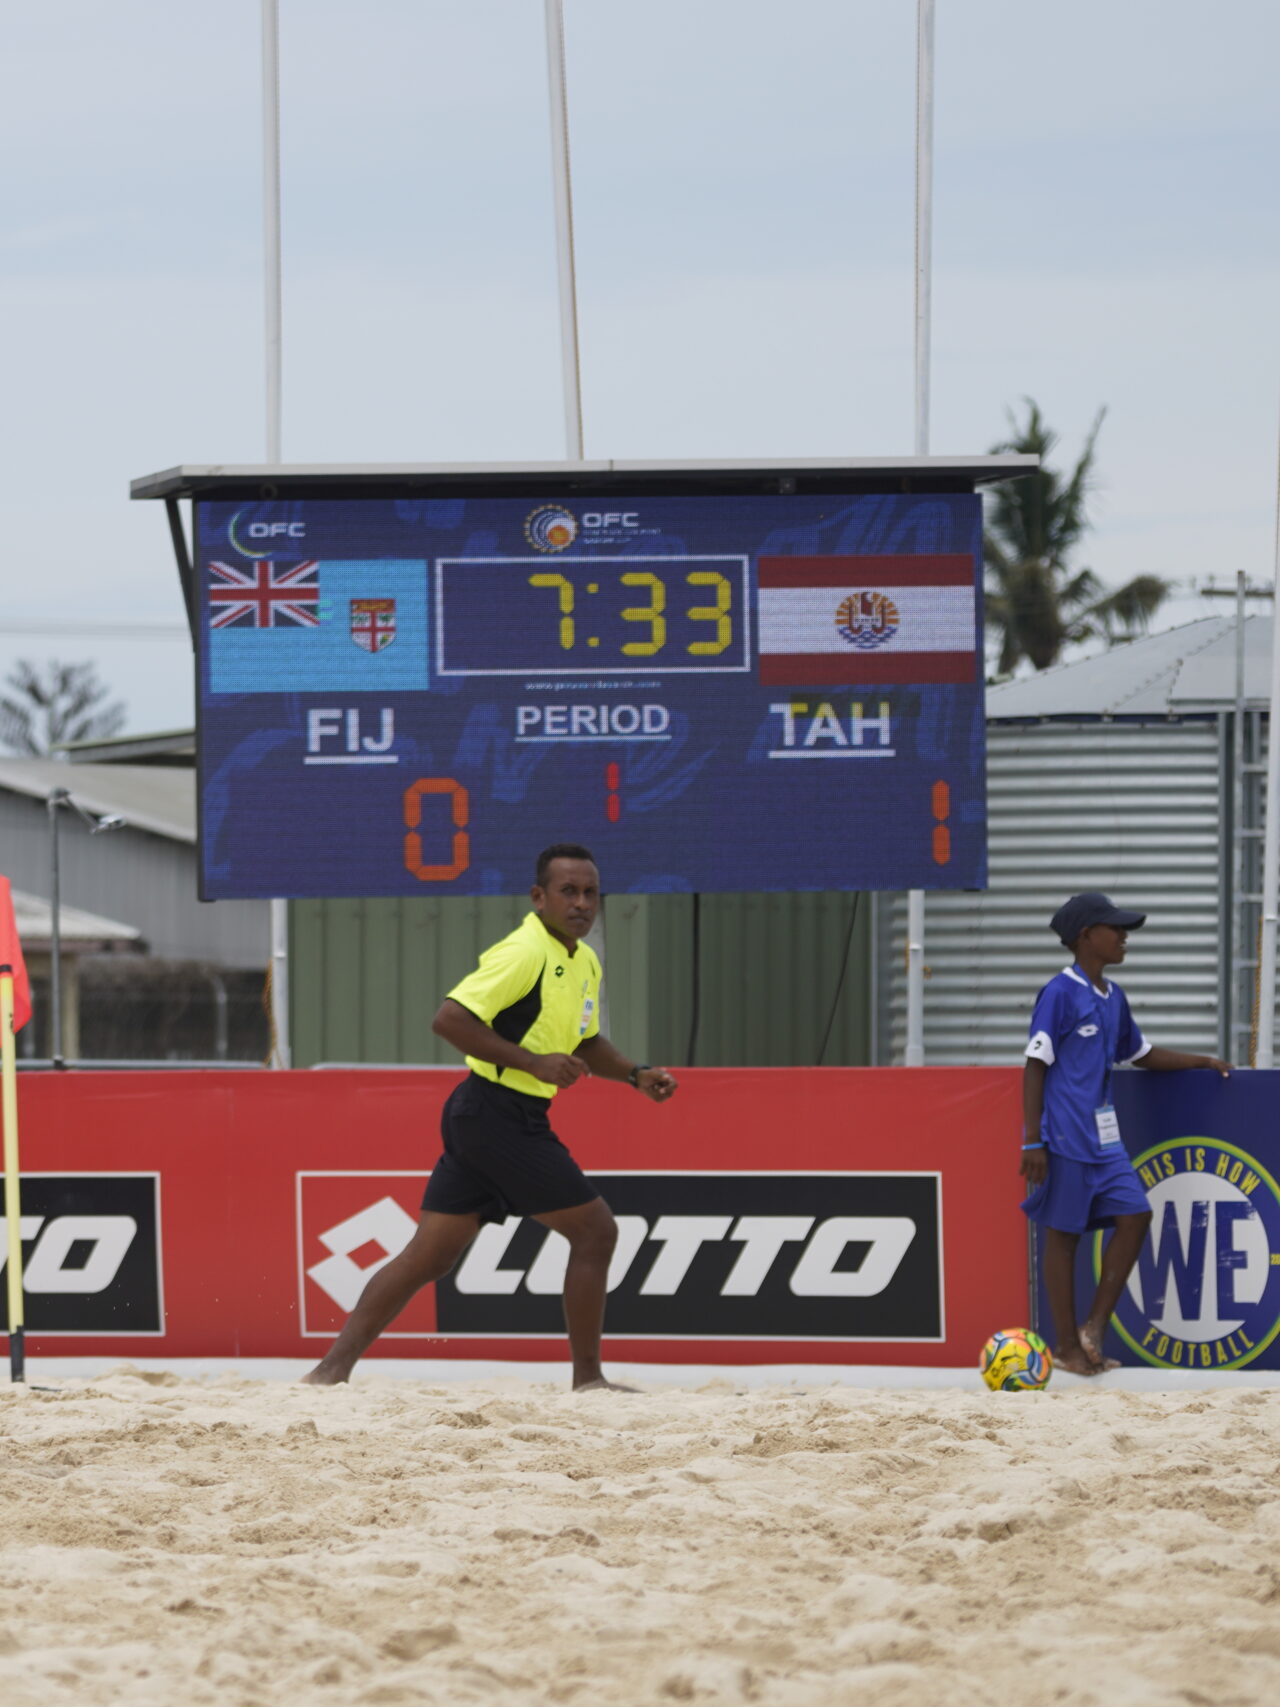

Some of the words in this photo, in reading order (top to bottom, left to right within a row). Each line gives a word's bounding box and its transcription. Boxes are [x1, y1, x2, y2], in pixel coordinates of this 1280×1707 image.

[249, 522, 306, 538] OFC
[583, 512, 640, 528] OFC
[528, 572, 733, 656] 7:33
[307, 708, 395, 753] FIJ
[517, 704, 670, 736] PERIOD
[768, 702, 891, 747] TAH
[605, 761, 621, 824] 1
[403, 777, 470, 881] 0
[932, 779, 951, 867] 1
[1138, 1152, 1176, 1188] HIS
[1185, 1147, 1206, 1172] IS
[1216, 1153, 1261, 1196] HOW
[1133, 1200, 1257, 1321] WE
[1142, 1327, 1255, 1367] FOOTBALL
